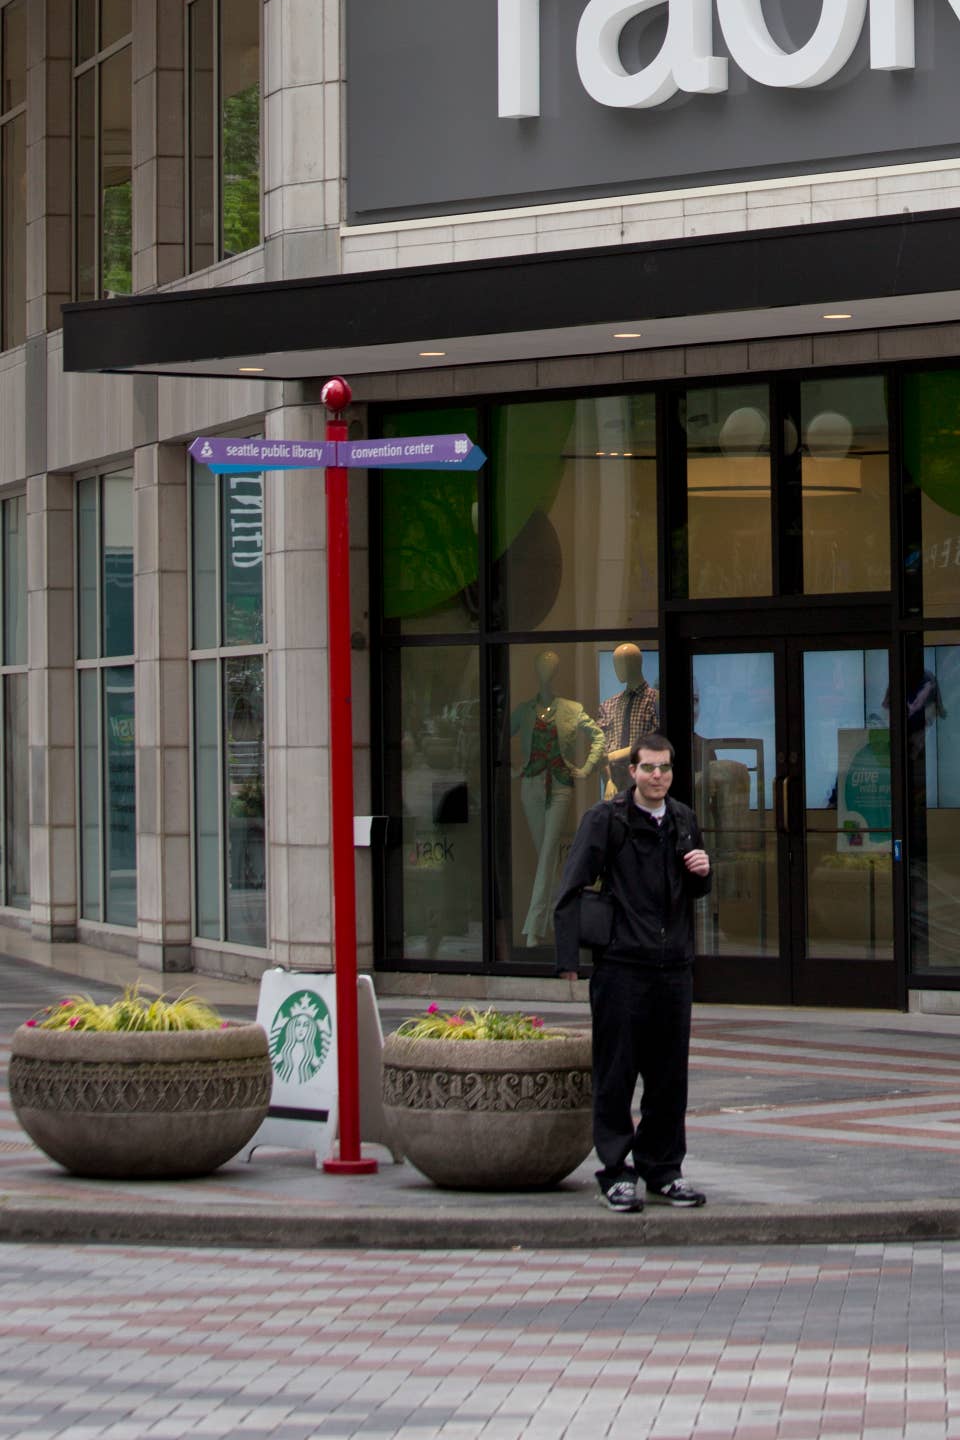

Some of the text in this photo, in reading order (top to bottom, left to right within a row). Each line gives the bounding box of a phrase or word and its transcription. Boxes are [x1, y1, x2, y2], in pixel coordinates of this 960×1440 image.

[226, 443, 323, 462] seattle public library
[351, 443, 434, 459] convention center
